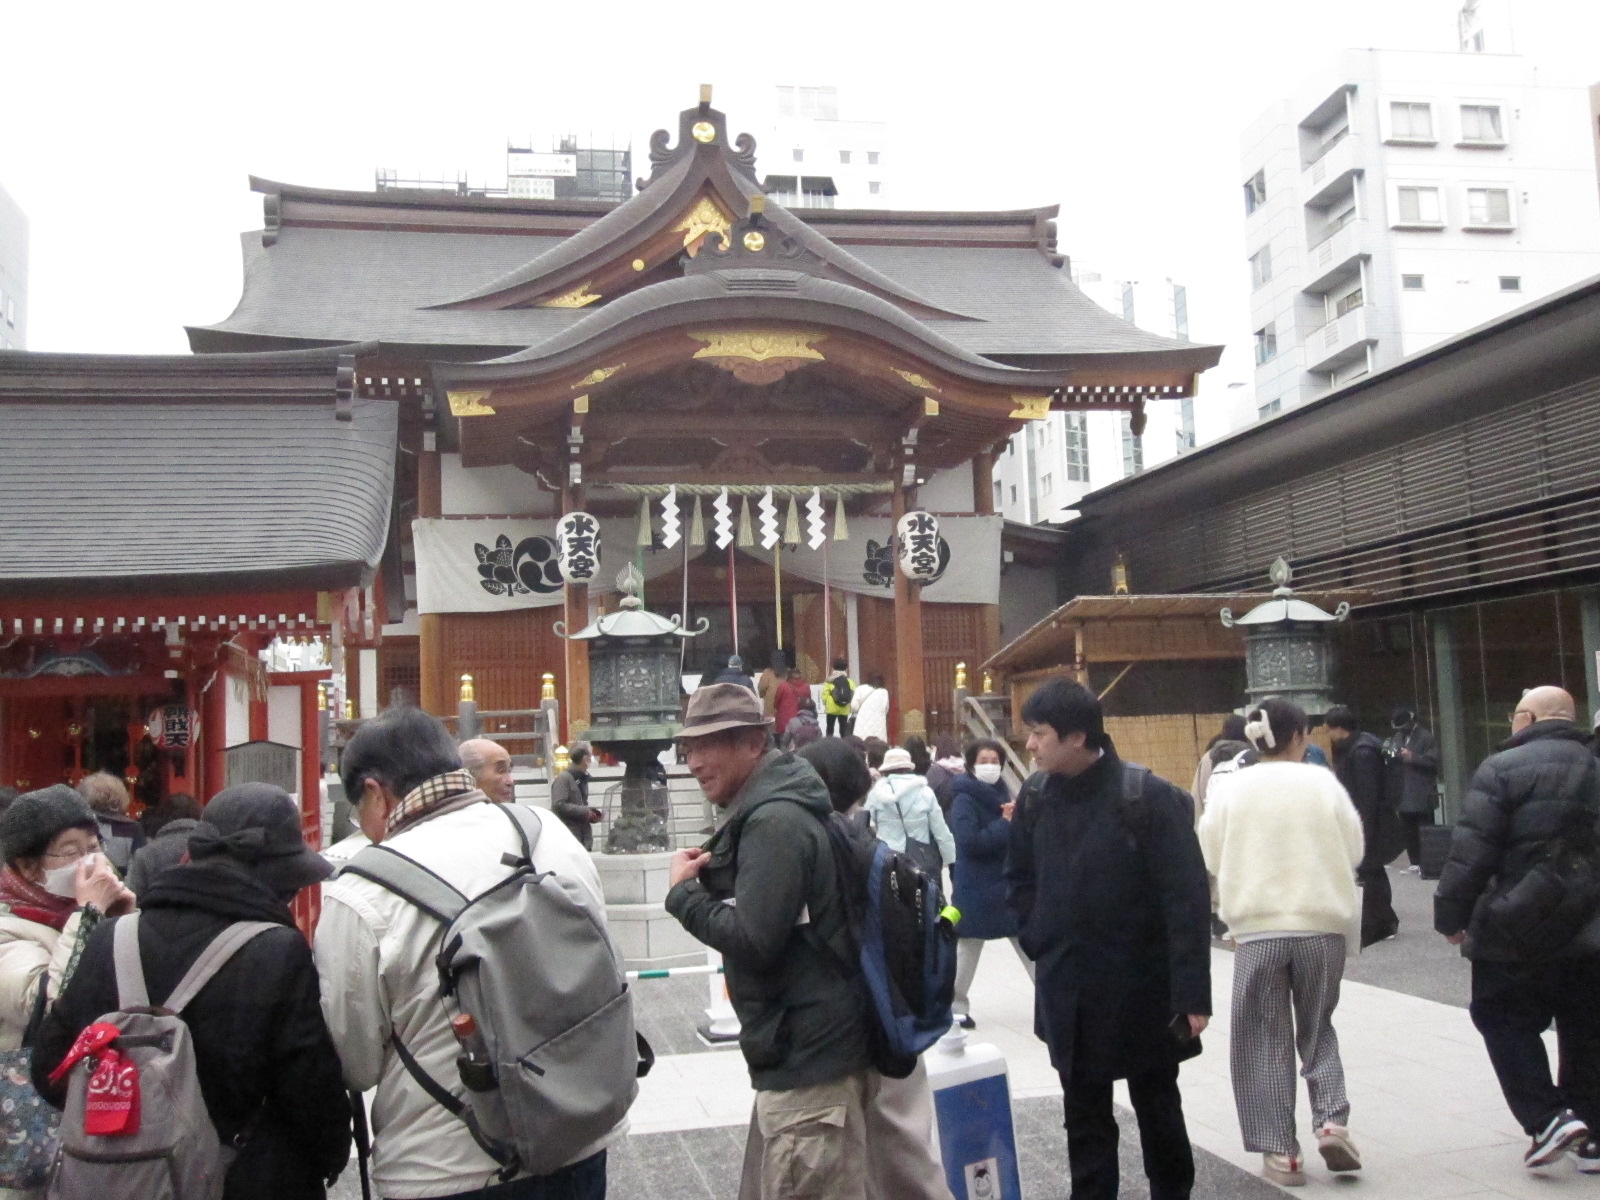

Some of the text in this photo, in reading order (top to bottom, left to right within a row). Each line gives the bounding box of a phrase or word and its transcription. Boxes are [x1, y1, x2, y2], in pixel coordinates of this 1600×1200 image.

[564, 515, 595, 579] 水天宮
[907, 514, 936, 575] 水天宮
